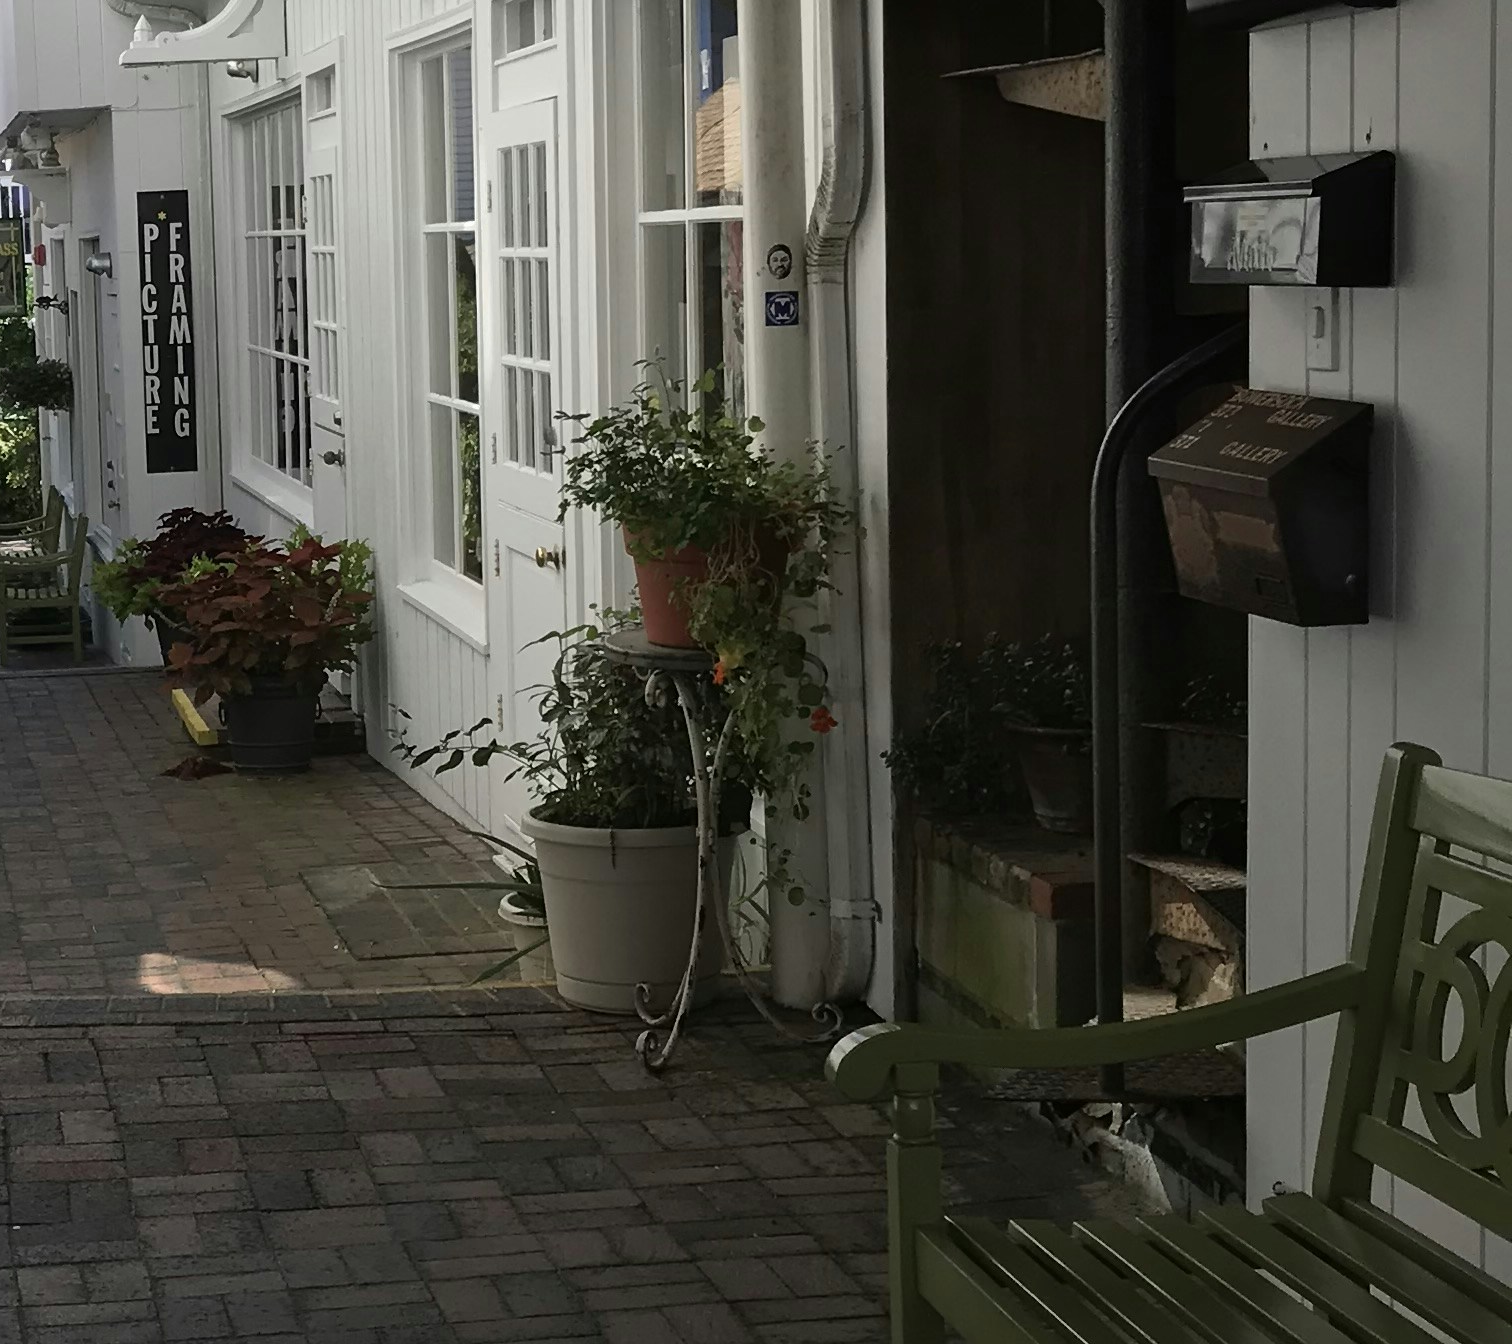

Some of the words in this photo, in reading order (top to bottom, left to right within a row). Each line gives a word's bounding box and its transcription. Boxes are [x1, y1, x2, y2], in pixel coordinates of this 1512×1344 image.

[141, 223, 161, 435] PICTURE
[168, 222, 192, 438] FRAMING
[1219, 441, 1289, 465] GALLERY
[1266, 408, 1334, 430] GALLERY
